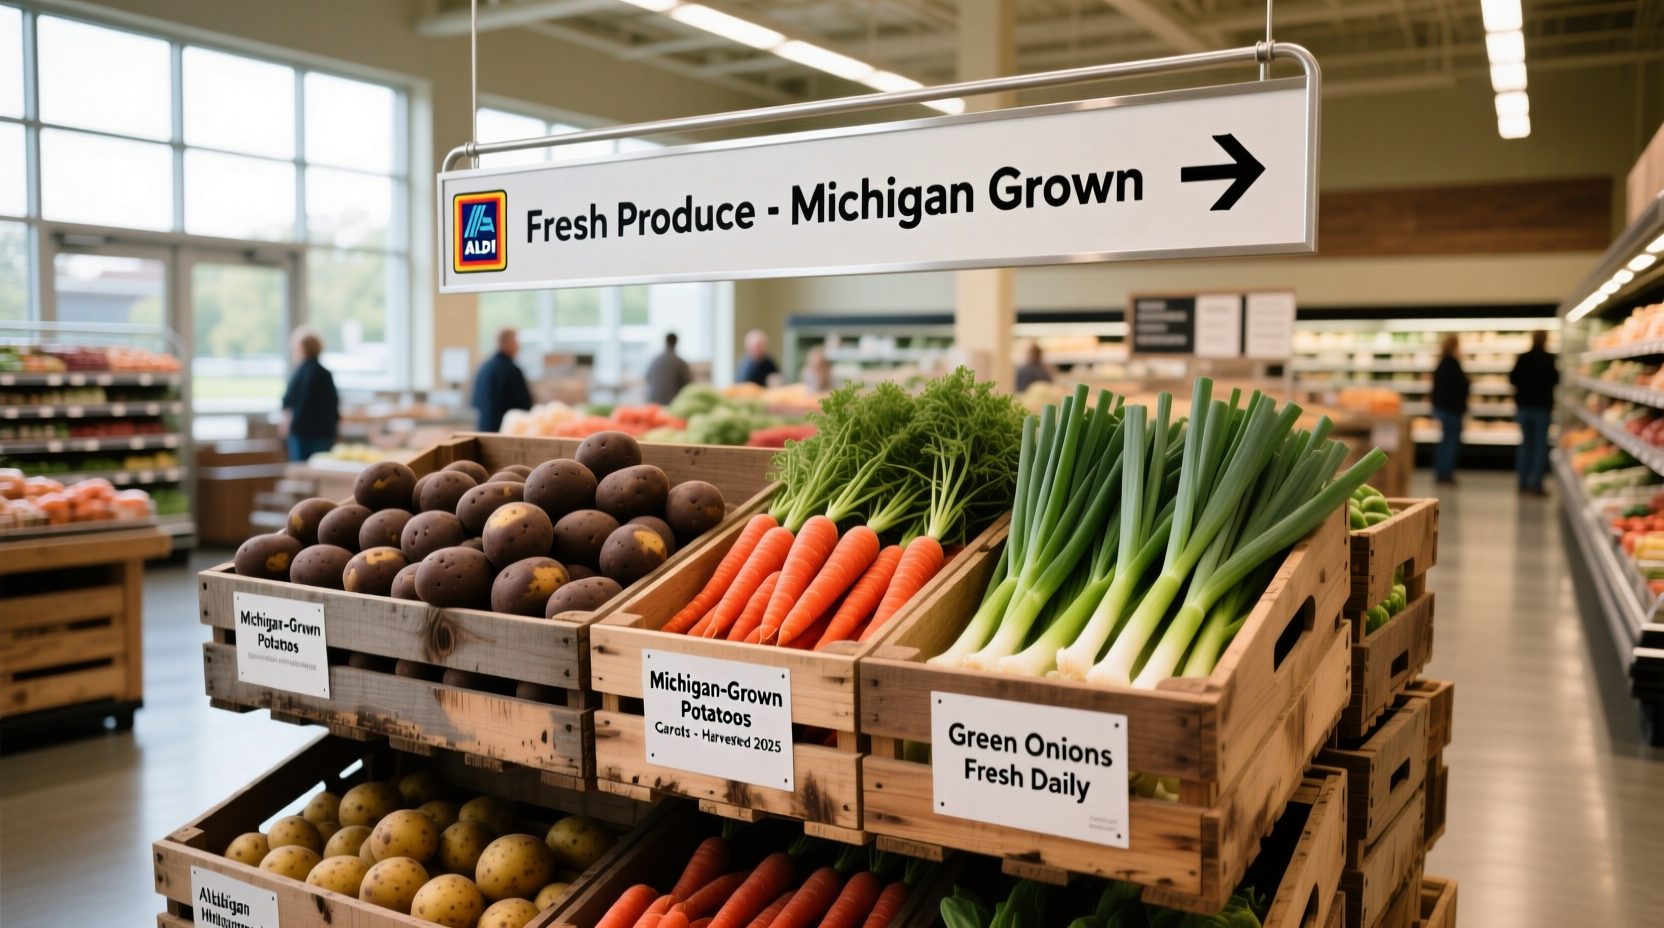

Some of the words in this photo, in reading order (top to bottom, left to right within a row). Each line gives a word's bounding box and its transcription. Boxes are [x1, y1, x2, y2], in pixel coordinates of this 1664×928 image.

[526, 203, 607, 243] Fresh
[618, 195, 756, 237] Produce
[791, 175, 974, 229] Michigan
[989, 166, 1144, 212] Grown
[464, 239, 497, 256] ALDI
[650, 670, 783, 707] Michigan-Grown
[753, 737, 782, 753] 2025
[948, 722, 1017, 754] Green
[1025, 732, 1113, 767] Onions
[964, 758, 1024, 788] Fresh
[1031, 767, 1091, 804] Daily
